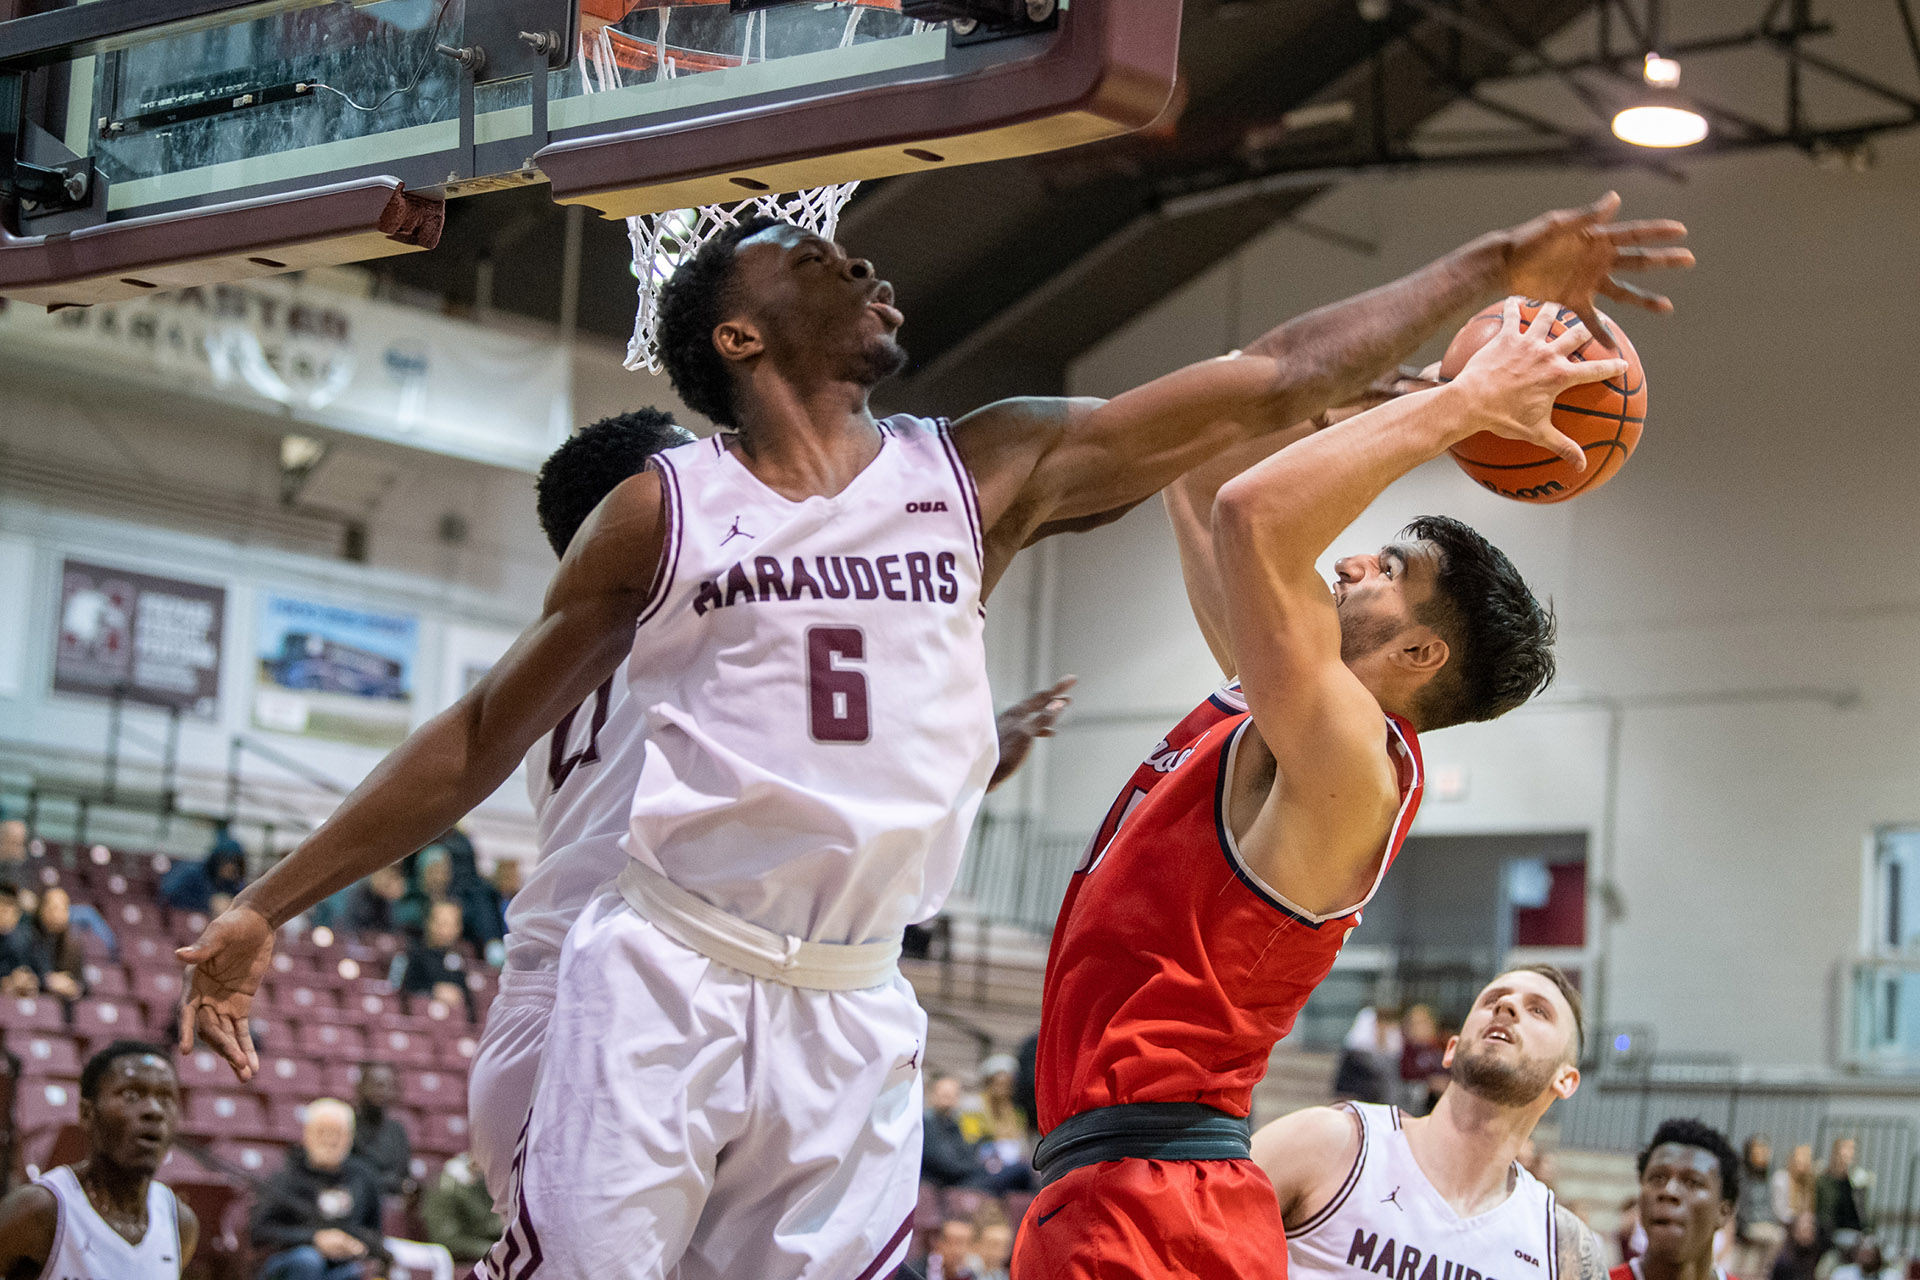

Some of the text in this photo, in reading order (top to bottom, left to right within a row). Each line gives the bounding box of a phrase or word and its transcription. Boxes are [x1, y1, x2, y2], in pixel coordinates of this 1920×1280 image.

[905, 501, 948, 513] OUA
[693, 551, 958, 616] MARAUDERS
[806, 623, 872, 745] 6
[1346, 1227, 1500, 1280] MARAU
[1514, 1249, 1540, 1268] OUA
